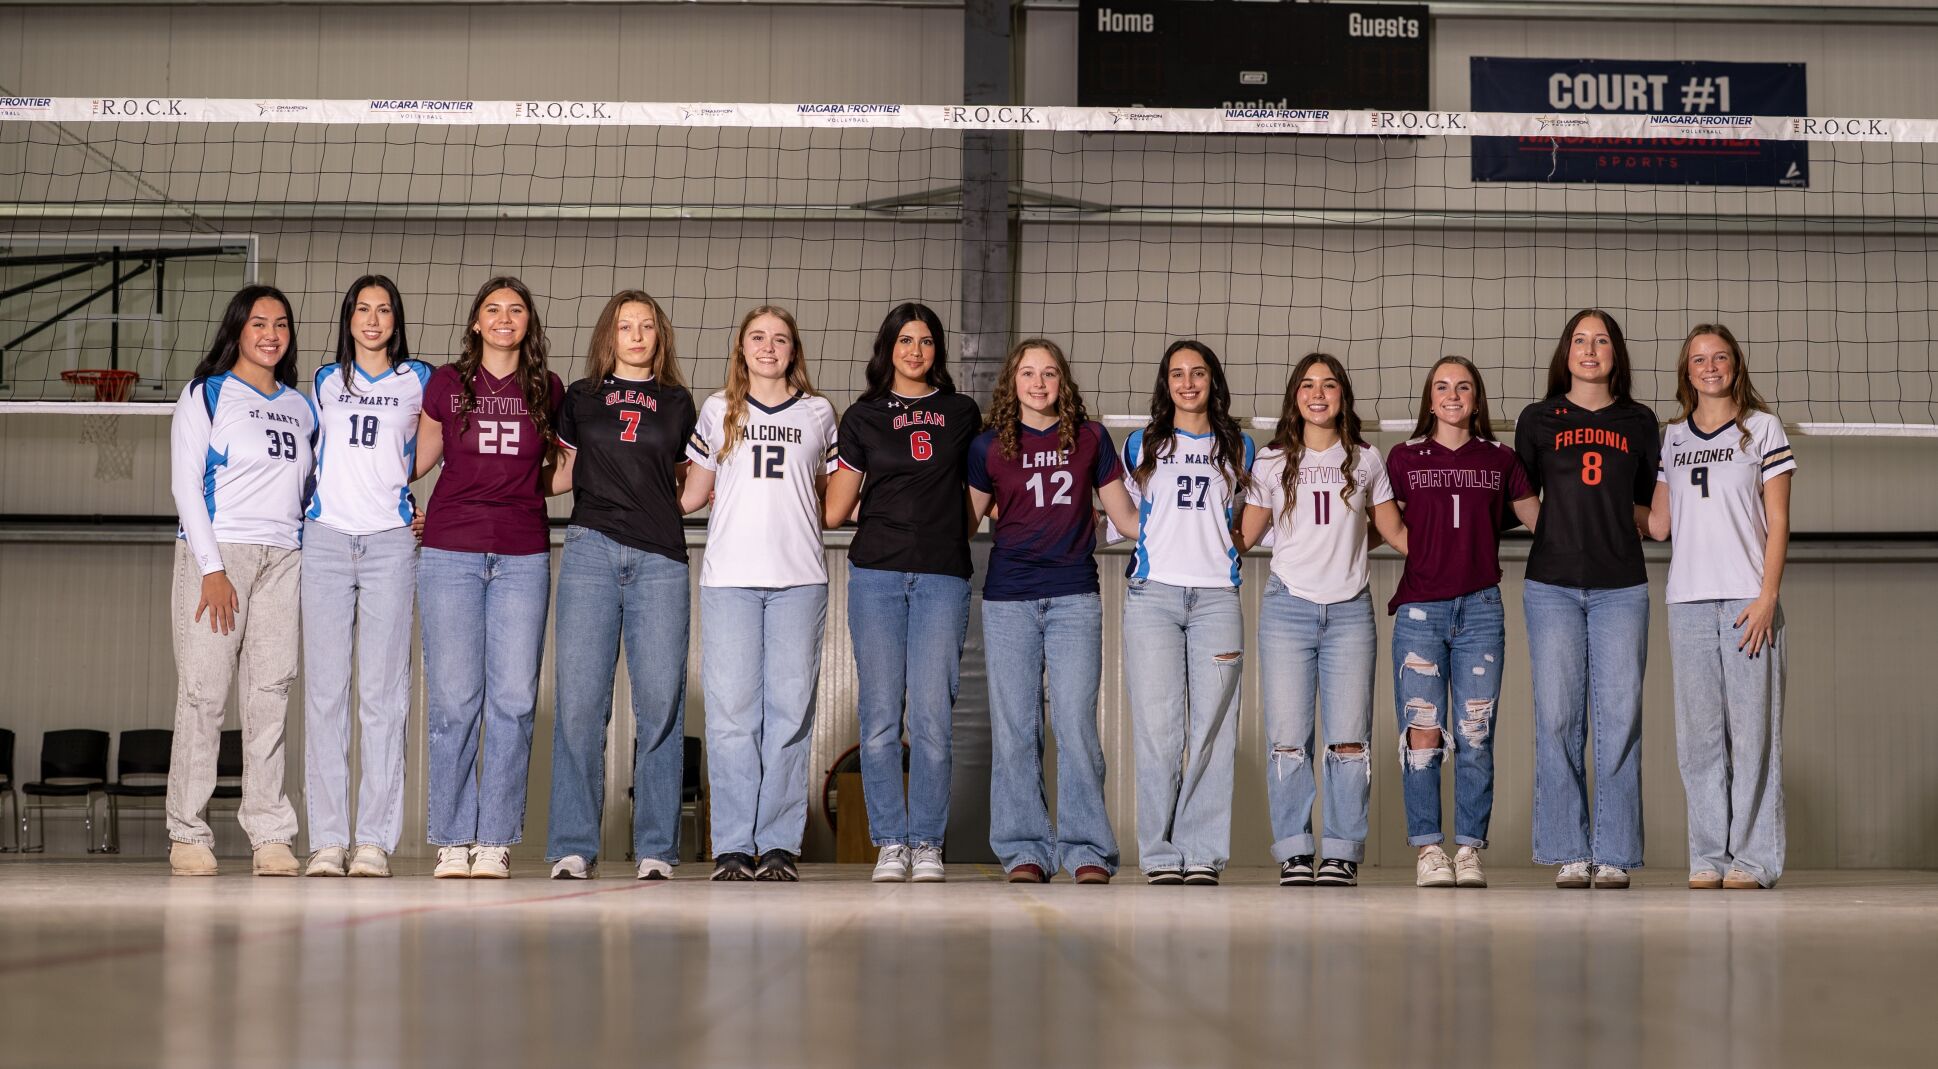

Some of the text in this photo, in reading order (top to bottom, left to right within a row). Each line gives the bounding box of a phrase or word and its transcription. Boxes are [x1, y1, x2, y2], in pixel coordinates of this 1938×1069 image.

[1098, 8, 1154, 32] Home
[1349, 12, 1419, 38] Guests
[0, 98, 51, 107] FRONTIER
[1549, 72, 1730, 112] COURT #1
[102, 100, 187, 115] R.O.C.K.
[370, 101, 473, 110] NIAGARA FRONTIER
[526, 103, 611, 118] R.O.C.K.
[797, 104, 901, 113] NIAGARA FRONTIER
[953, 107, 1040, 123] R.O.C.K.
[1225, 109, 1329, 119] NIAGARA FRONTIER
[1381, 112, 1466, 129] R.O.C.K.
[1650, 115, 1752, 125] NIAGARA FRONTIER
[1803, 119, 1888, 135] R.O.C.K.
[1599, 156, 1679, 168] SPORTS
[338, 394, 399, 407] ST. MARY'S
[450, 394, 530, 416] PRTVIL
[605, 390, 657, 412] OLEAN
[266, 411, 300, 427] MARY'S
[619, 410, 641, 442] 7
[893, 411, 945, 430] OLEAN
[349, 414, 380, 449] 18
[477, 420, 520, 456] 22
[1555, 428, 1629, 453] FREDONIA
[265, 429, 297, 462] 39
[910, 430, 932, 461] 6
[751, 444, 785, 480] 12
[1022, 449, 1069, 469] LAKE
[1162, 454, 1178, 465] ST.
[1674, 448, 1734, 467] FALCONER
[1581, 451, 1602, 486] 8
[1025, 470, 1073, 508] 12
[1407, 469, 1501, 490] PORTVILLE
[1691, 466, 1710, 498] 9
[1176, 475, 1210, 511] 27
[1312, 491, 1330, 525] 11
[1451, 494, 1460, 528] 1
